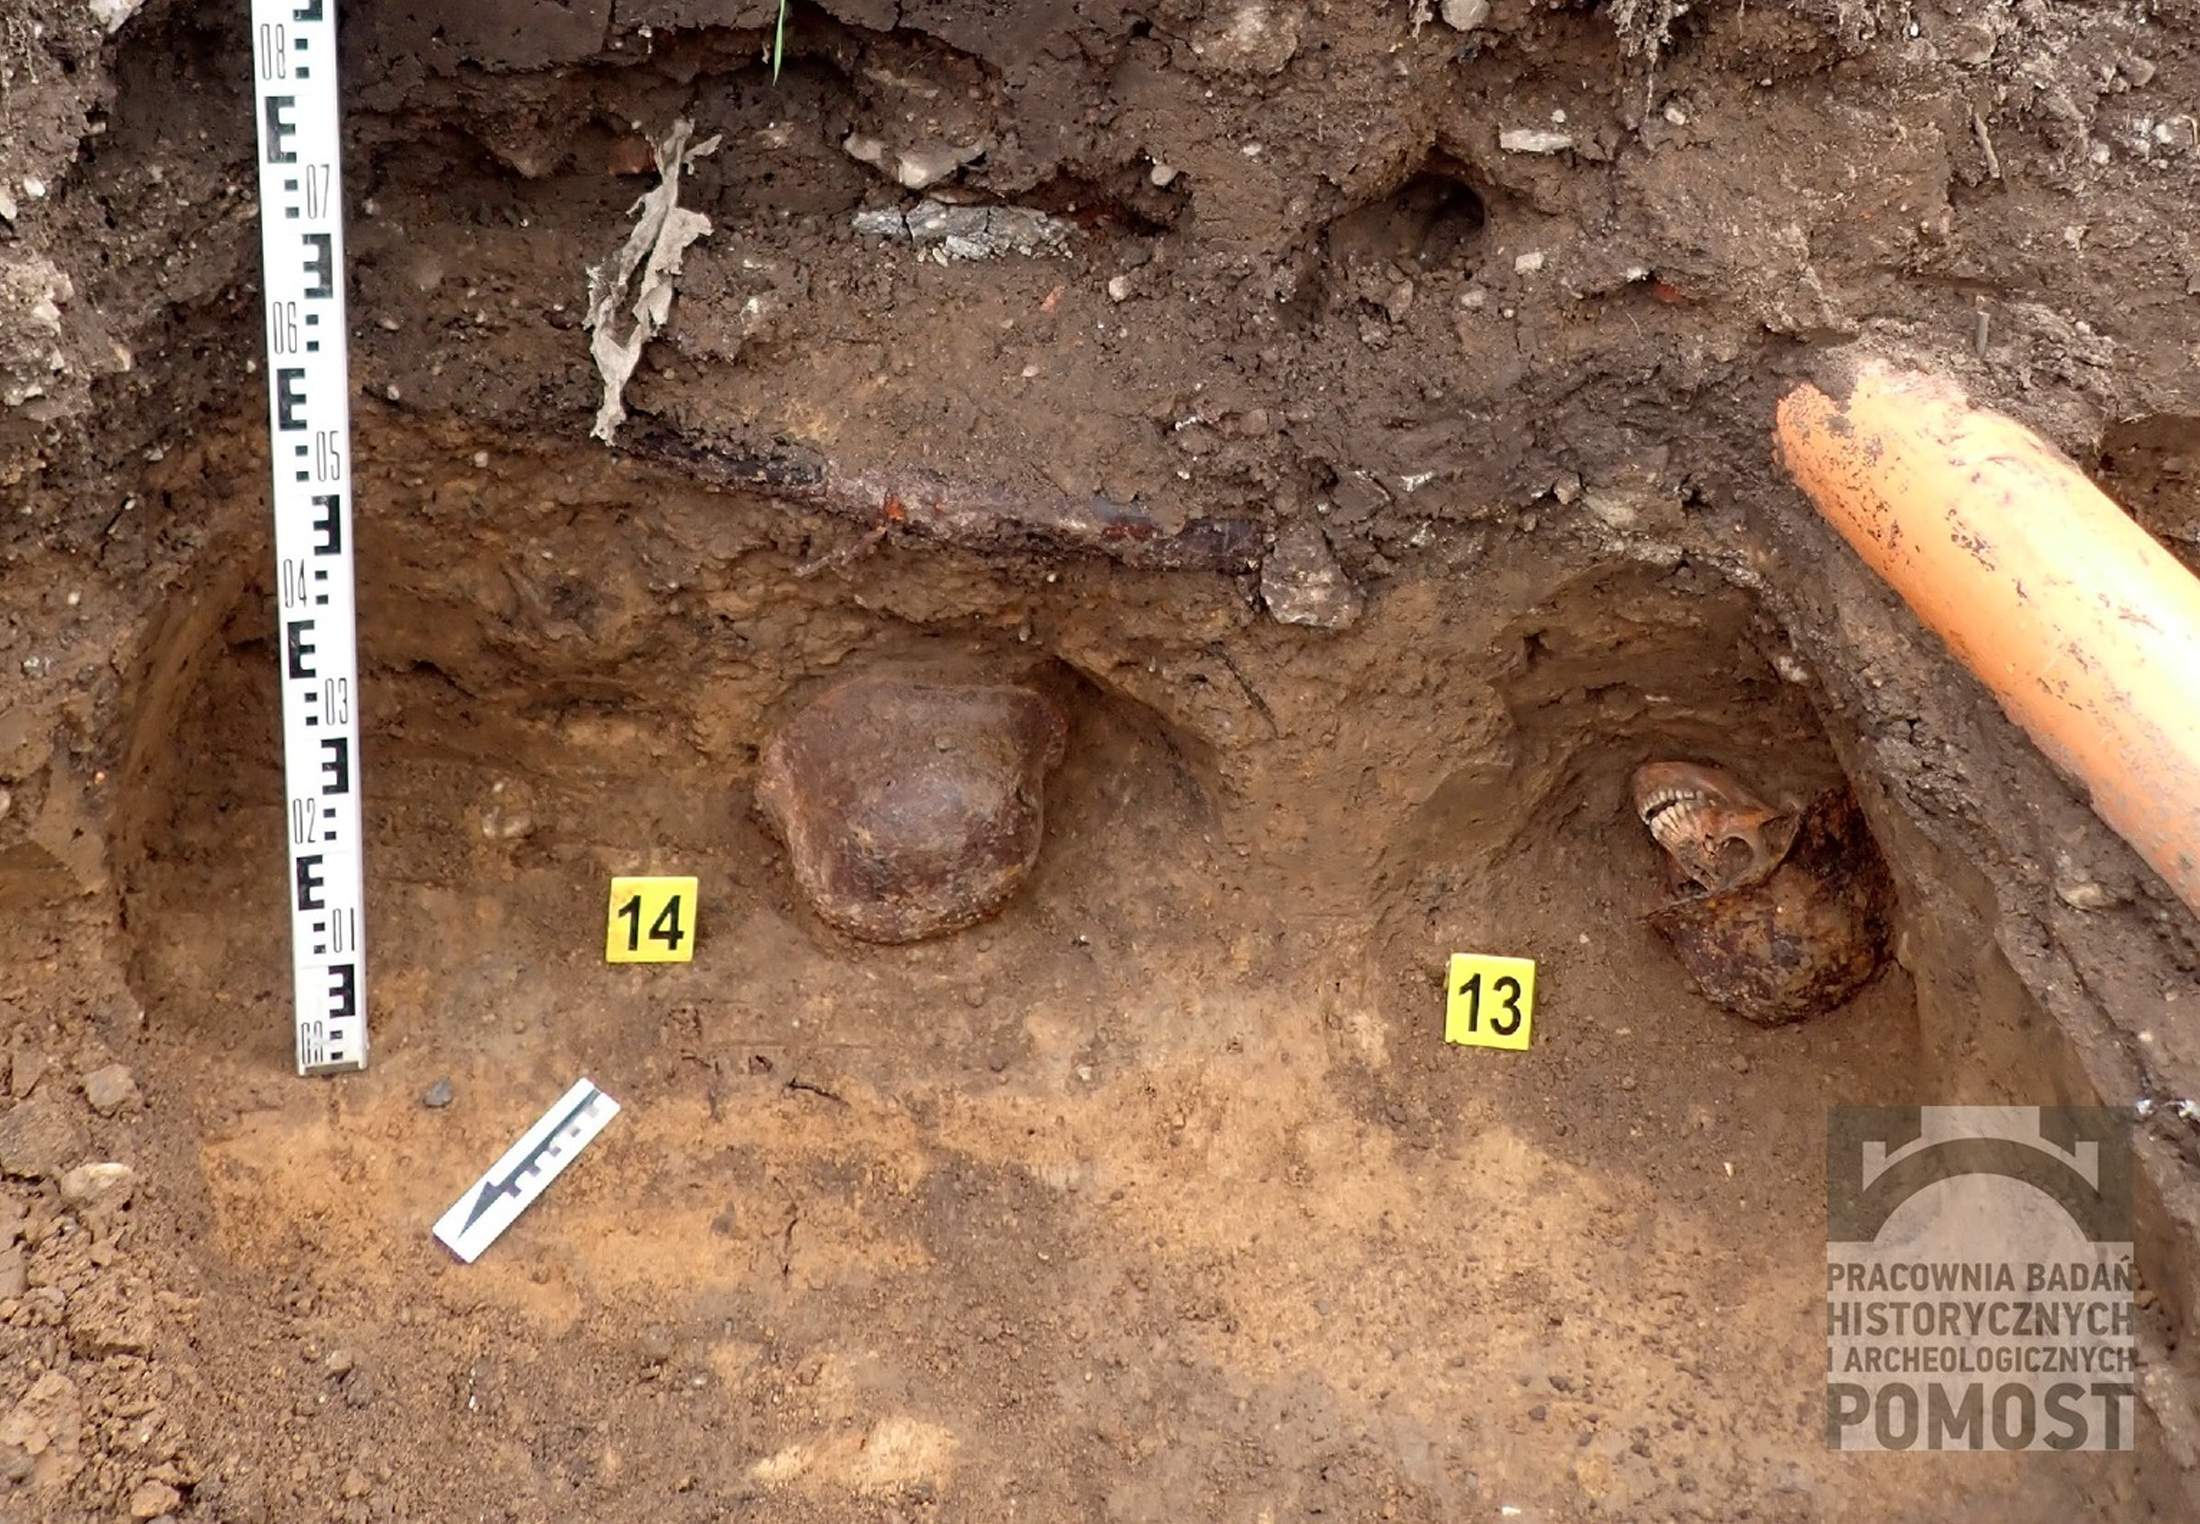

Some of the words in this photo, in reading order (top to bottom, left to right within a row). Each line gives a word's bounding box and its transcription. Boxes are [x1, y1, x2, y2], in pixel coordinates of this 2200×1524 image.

[260, 23, 286, 81] 08
[306, 164, 330, 219] 07
[273, 301, 297, 355] 06
[316, 431, 340, 482] 05
[284, 558, 307, 608] 04
[325, 677, 348, 726] 03
[293, 798, 316, 844] 02
[333, 907, 355, 953] 01
[618, 894, 685, 951] 14
[1458, 972, 1521, 1036] 13
